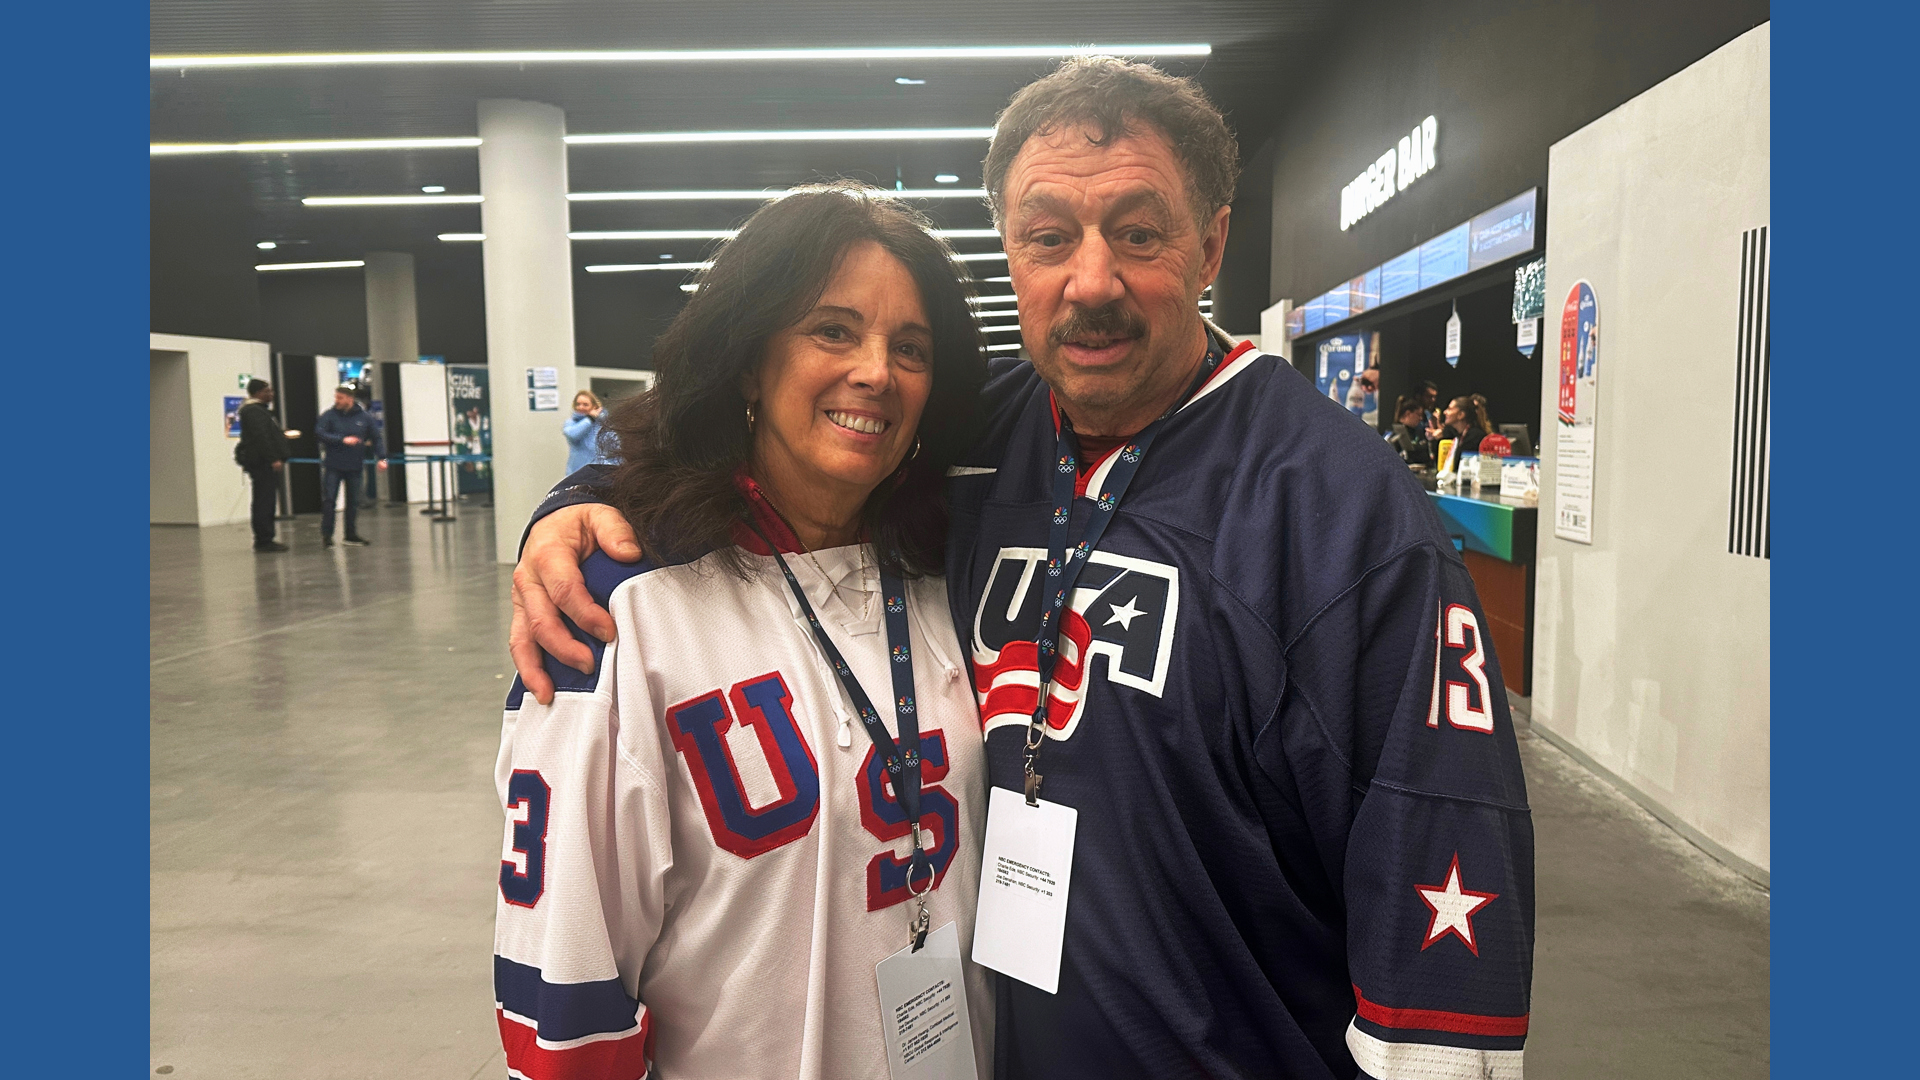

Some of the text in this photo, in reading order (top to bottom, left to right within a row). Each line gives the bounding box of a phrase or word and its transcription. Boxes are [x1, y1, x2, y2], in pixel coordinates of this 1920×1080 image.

[1340, 115, 1437, 231] BURGER BAR
[1319, 343, 1352, 354] Corona
[449, 386, 482, 400] STORE
[972, 546, 1179, 743] USA
[500, 769, 551, 909] 3
[1006, 858, 1029, 870] EMERGENCY
[904, 991, 925, 1007] EMERGENCY
[930, 1020, 942, 1030] Comcast
[943, 1011, 954, 1021] Medical
[914, 1044, 924, 1052] Global
[924, 1034, 939, 1045] Response
[942, 1021, 958, 1034] Intelligence
